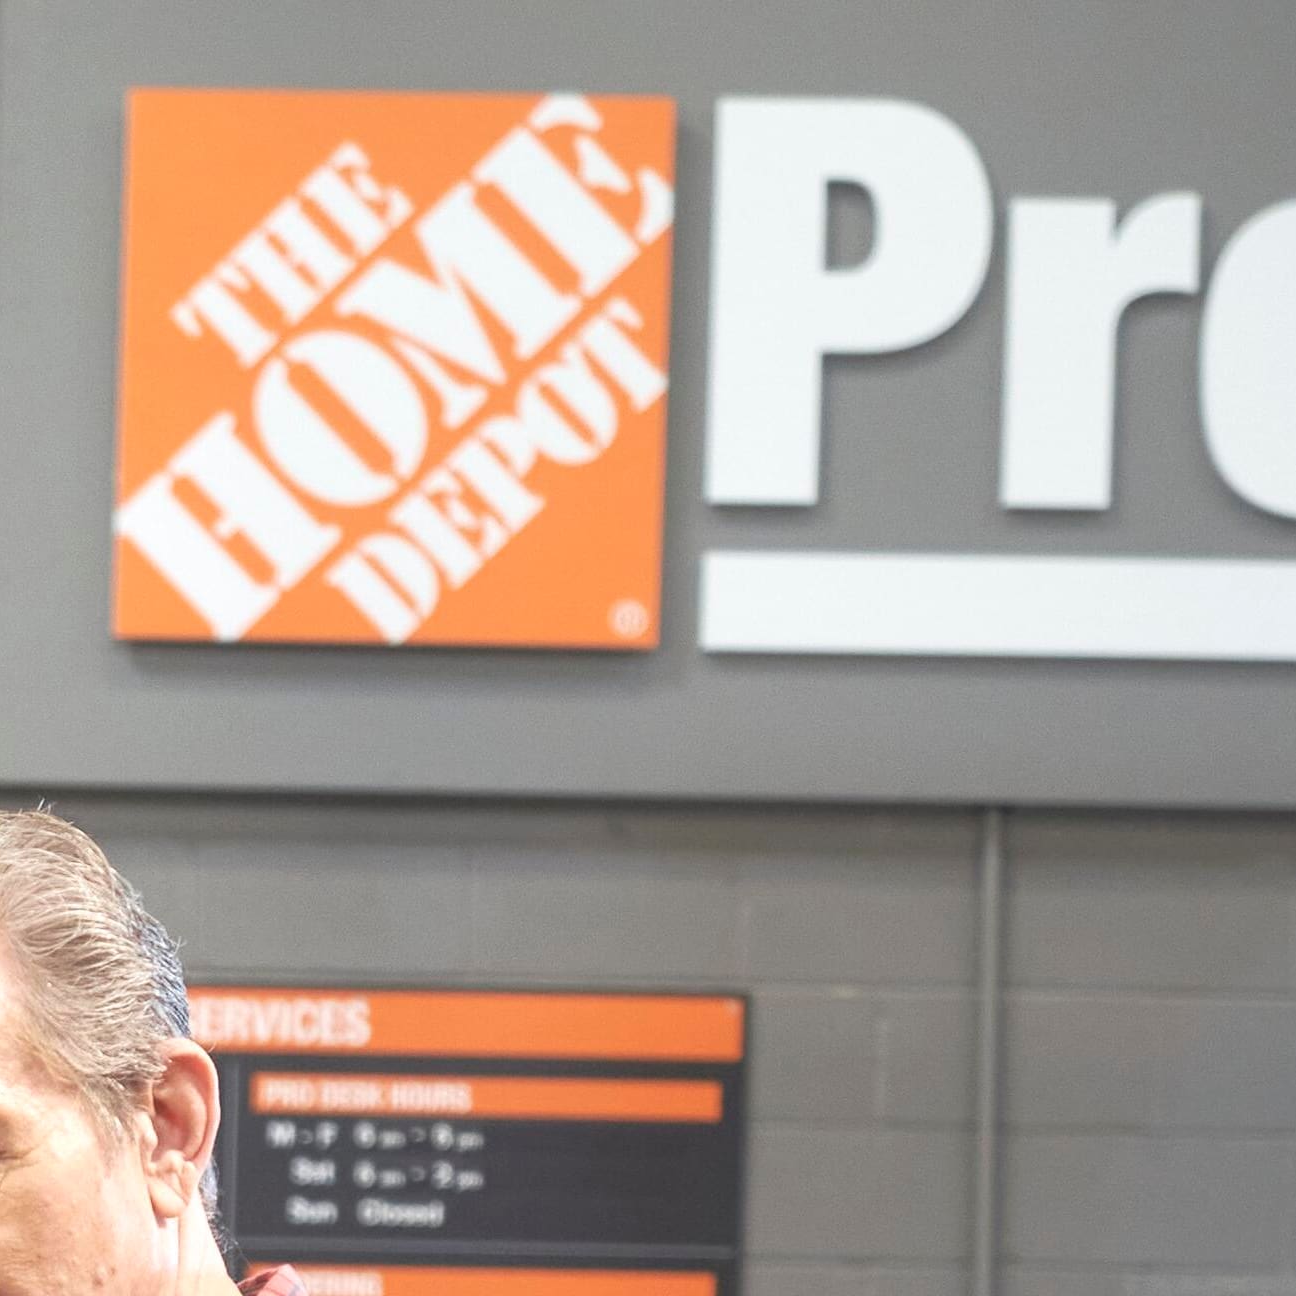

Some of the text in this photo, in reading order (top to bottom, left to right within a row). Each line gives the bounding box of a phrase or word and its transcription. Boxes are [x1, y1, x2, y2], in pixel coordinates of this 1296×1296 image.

[115, 93, 675, 642] HOME
[170, 143, 414, 367] THE
[324, 297, 669, 643] DEPOT
